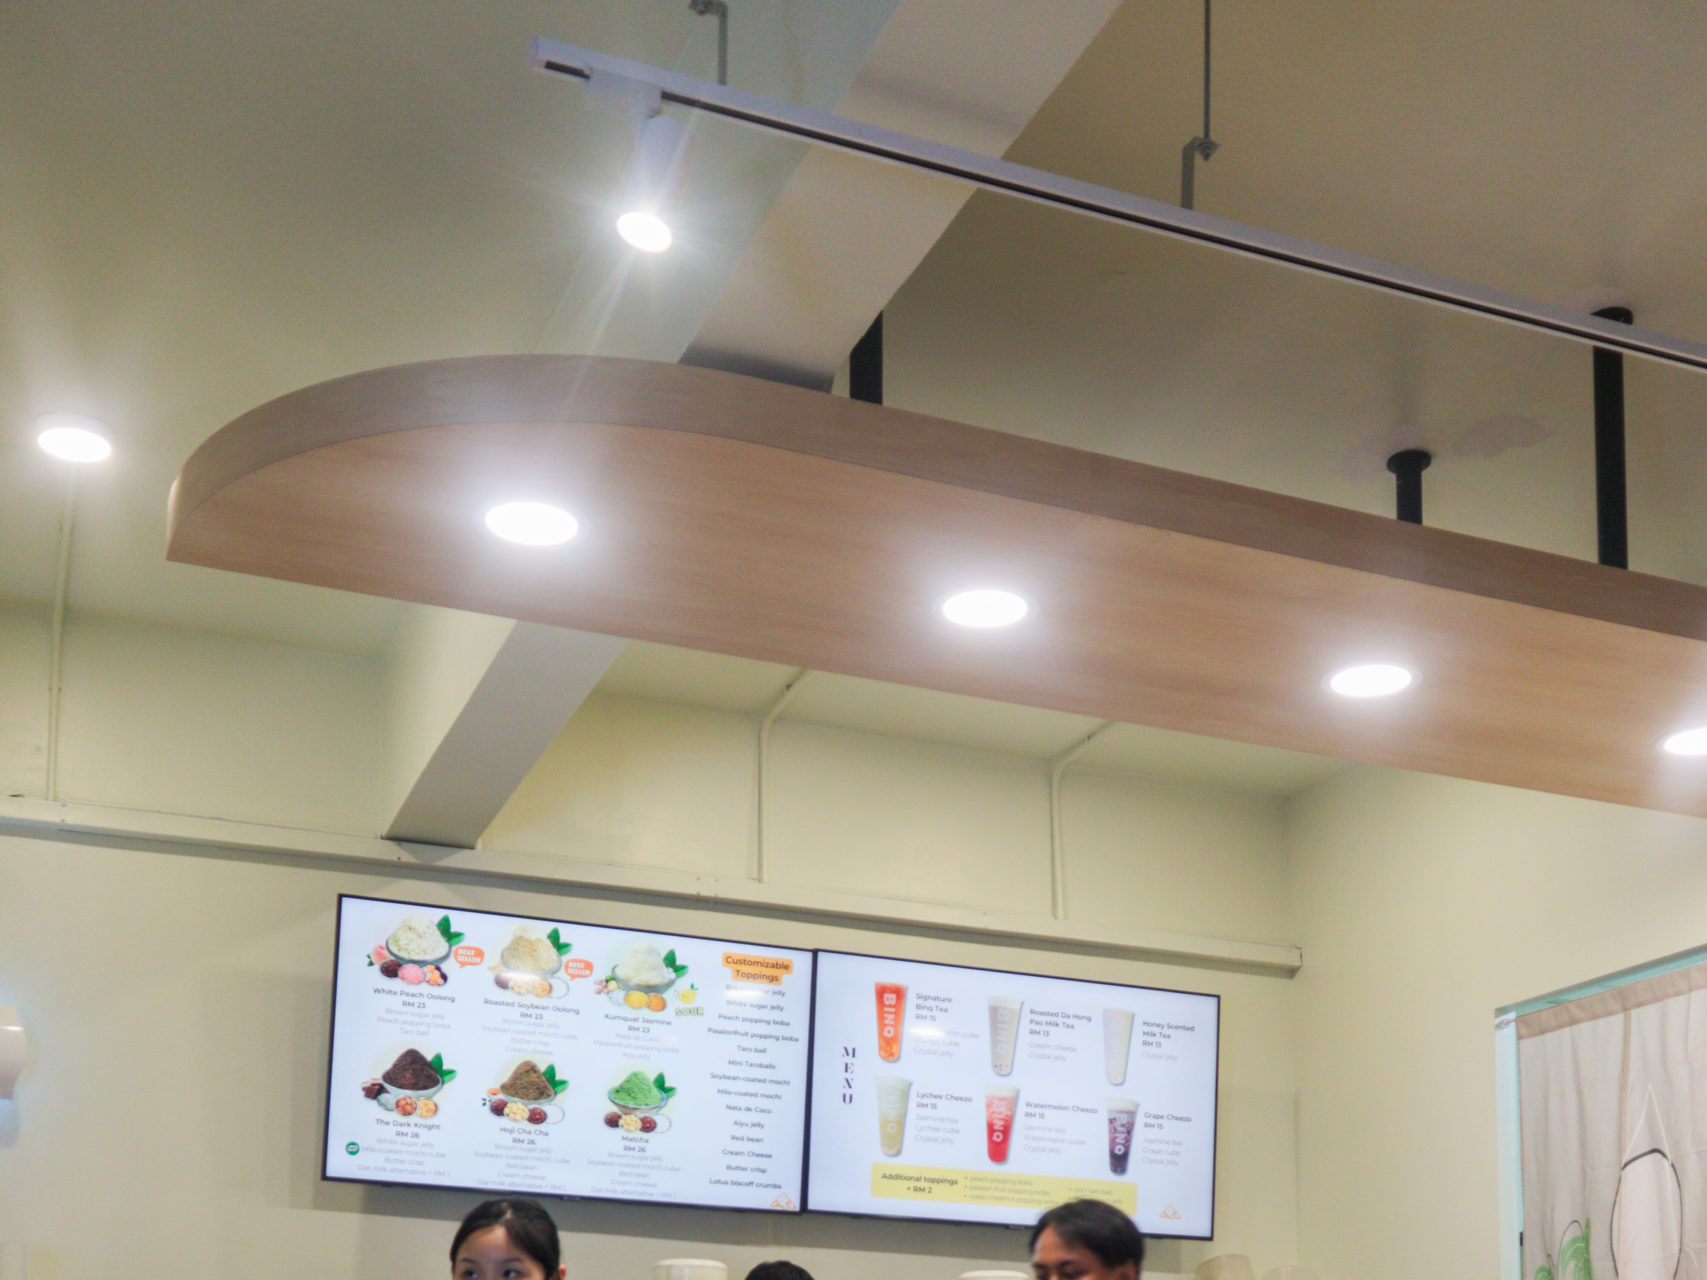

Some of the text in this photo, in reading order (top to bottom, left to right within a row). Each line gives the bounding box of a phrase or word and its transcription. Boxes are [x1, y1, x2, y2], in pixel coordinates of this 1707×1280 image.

[725, 956, 791, 971] Customizable
[736, 969, 780, 983] Toppings
[373, 986, 455, 1003] White Peach Oolong
[916, 992, 953, 1004] Signature
[483, 998, 580, 1015] Roasted Soybean Oolong
[675, 1006, 704, 1017] SOUR
[915, 1003, 949, 1013] Binq Tea
[604, 1013, 672, 1026] Kumquat Jasmine
[718, 1013, 790, 1027] Peach popping boba
[883, 993, 897, 1038] BINQ
[1029, 1008, 1092, 1023] Roasted Da Hong
[1029, 1018, 1044, 1026] Pao
[1045, 1020, 1060, 1028] Milk
[1142, 1020, 1195, 1032] Honey Scented
[708, 1027, 799, 1042] Passionfruit popping boba
[737, 1045, 752, 1053] Taro
[745, 1061, 776, 1070] Taroballs
[842, 1046, 856, 1104] MENU
[916, 1091, 973, 1103] Lychee Cheezo
[1025, 1101, 1098, 1114] Watermelon Cheezo
[992, 1099, 1006, 1142] BINQ
[1144, 1112, 1192, 1122] Grape Cheezo
[375, 1118, 441, 1132] The Dark Knight
[499, 1126, 549, 1137] Hoji Cha Cha
[621, 1135, 649, 1144] Matcha
[731, 1134, 764, 1143] Red bean
[1114, 1113, 1128, 1155] BINQ
[722, 1148, 773, 1159] Cream Cheese
[726, 1164, 748, 1172] Butter
[881, 1173, 958, 1186] Additional toppings
